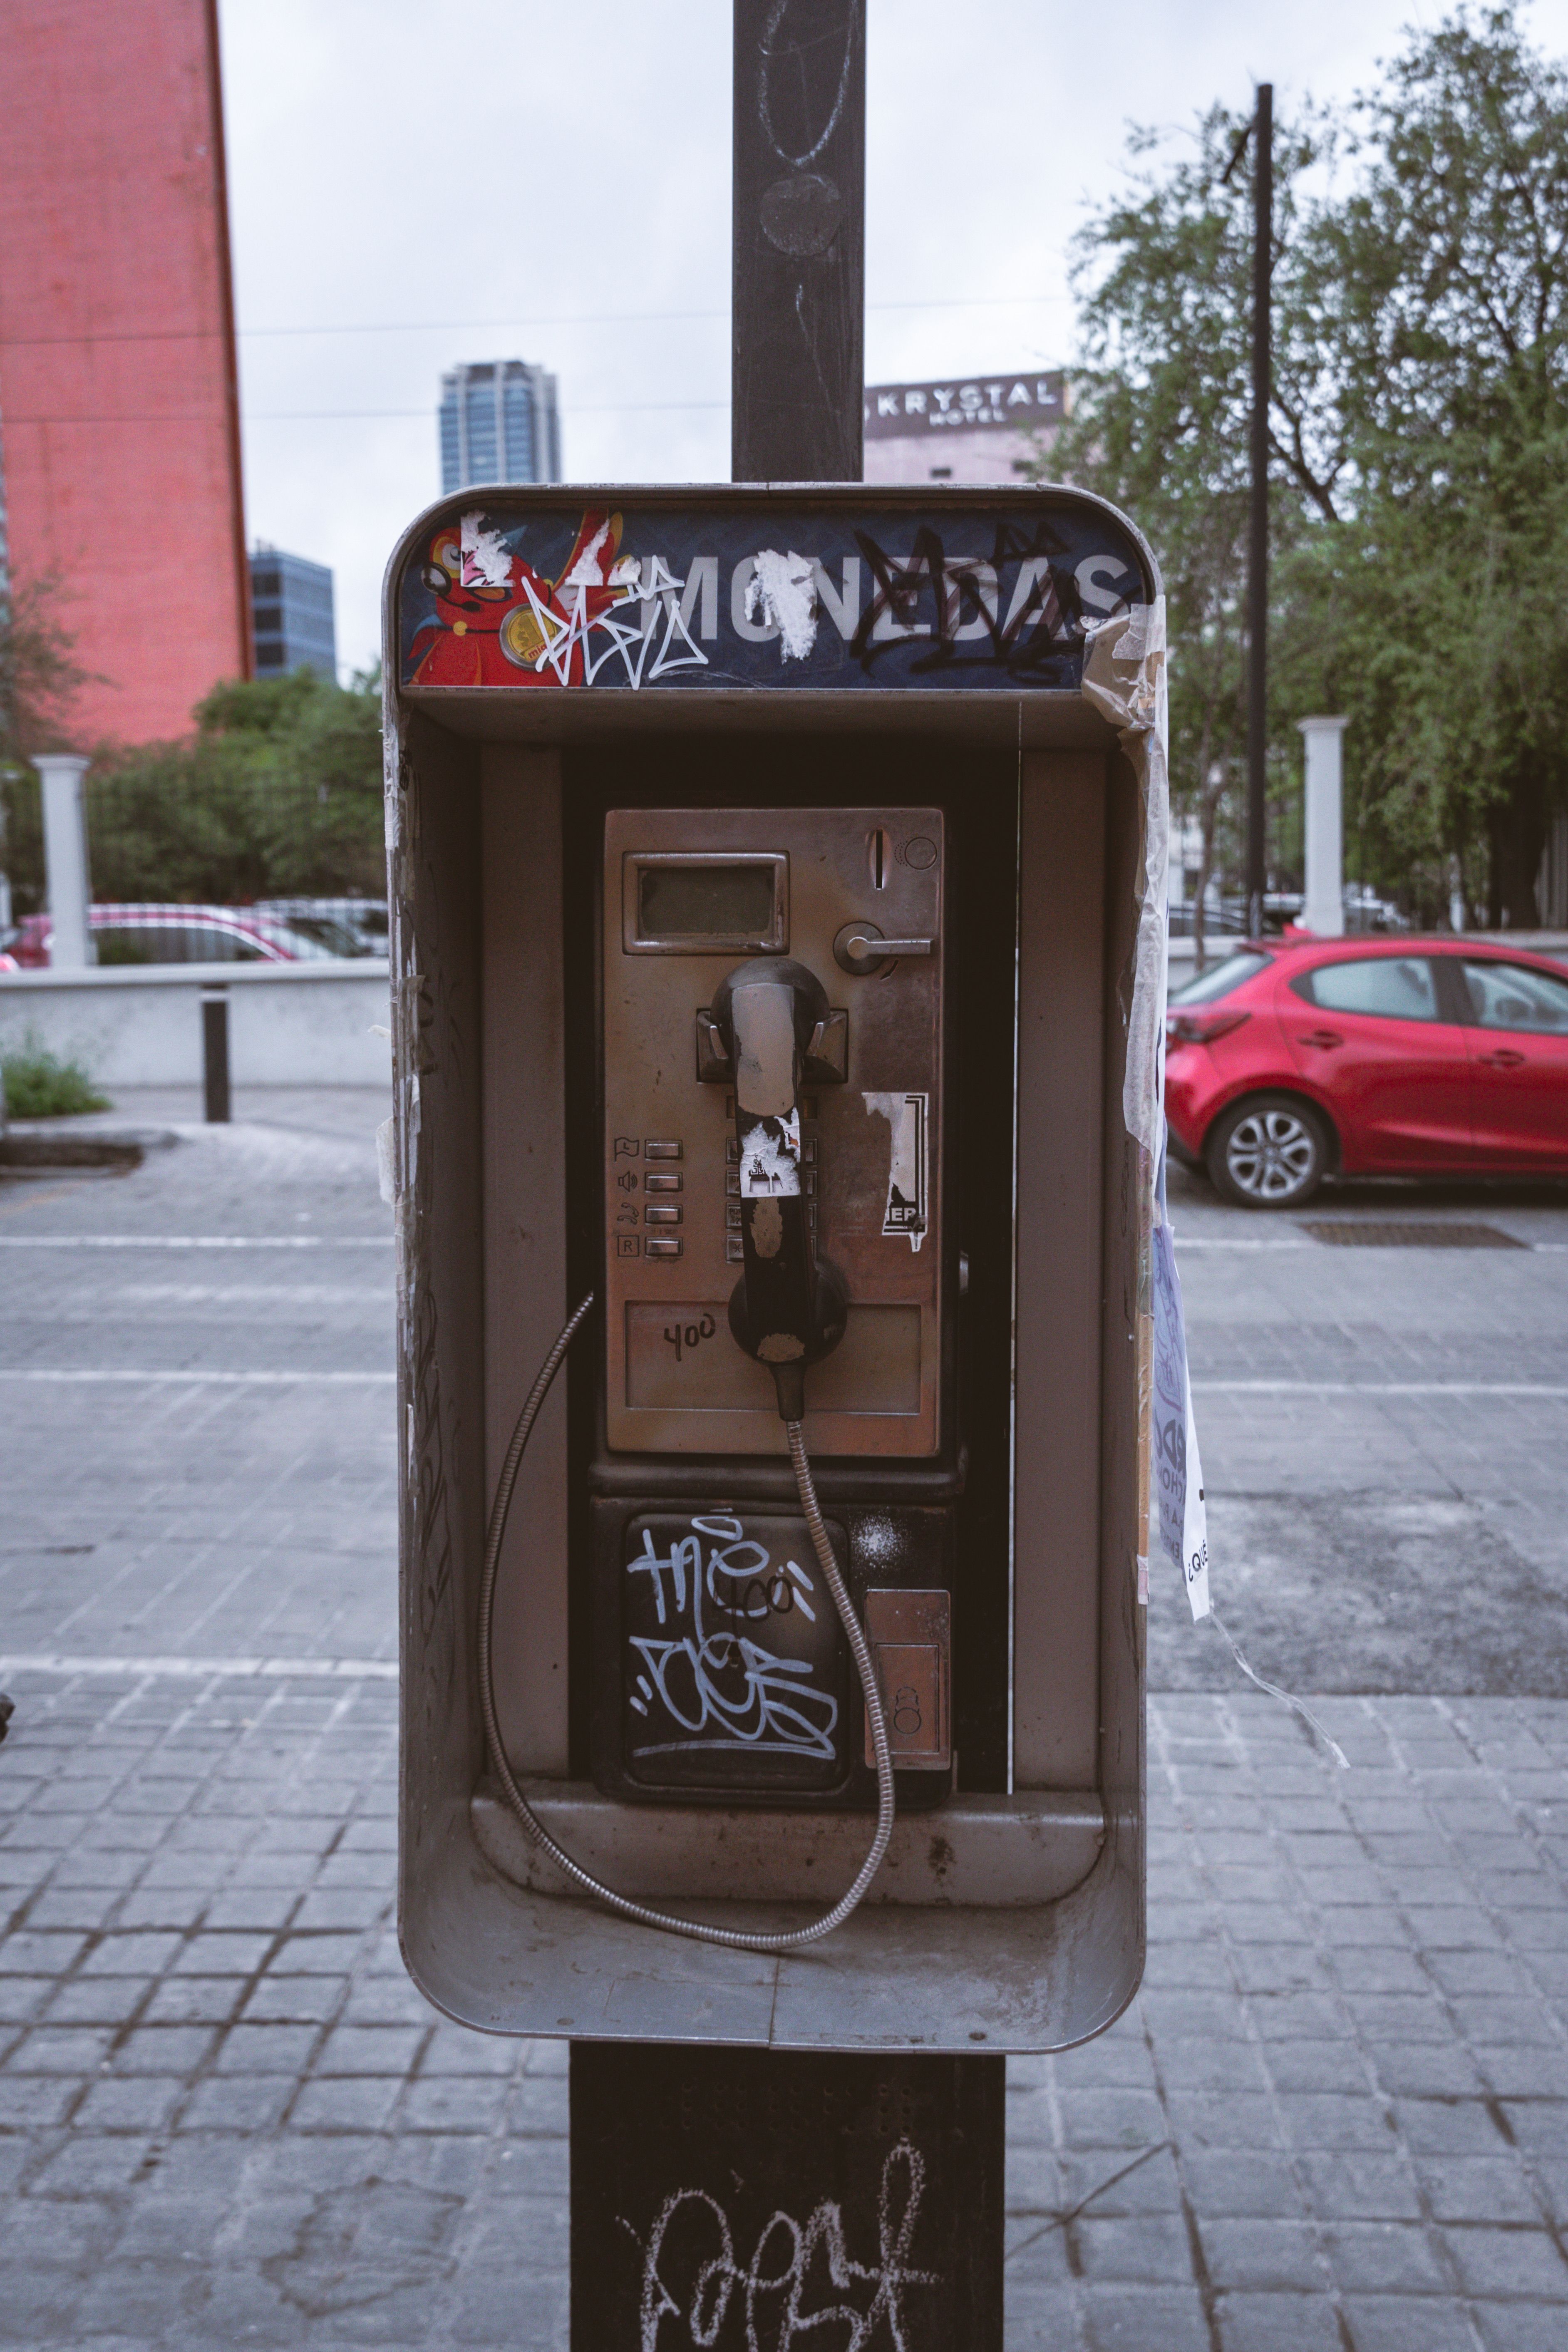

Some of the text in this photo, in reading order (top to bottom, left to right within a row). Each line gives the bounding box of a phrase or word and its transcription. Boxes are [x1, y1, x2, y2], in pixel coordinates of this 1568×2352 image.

[877, 380, 1057, 417] KRYSTAL
[929, 406, 1005, 427] HOTEL
[641, 554, 1129, 642] MONEDAS
[624, 1240, 633, 1252] R
[663, 1313, 717, 1362] 400
[1188, 1539, 1208, 1583] ¿QUÉ
